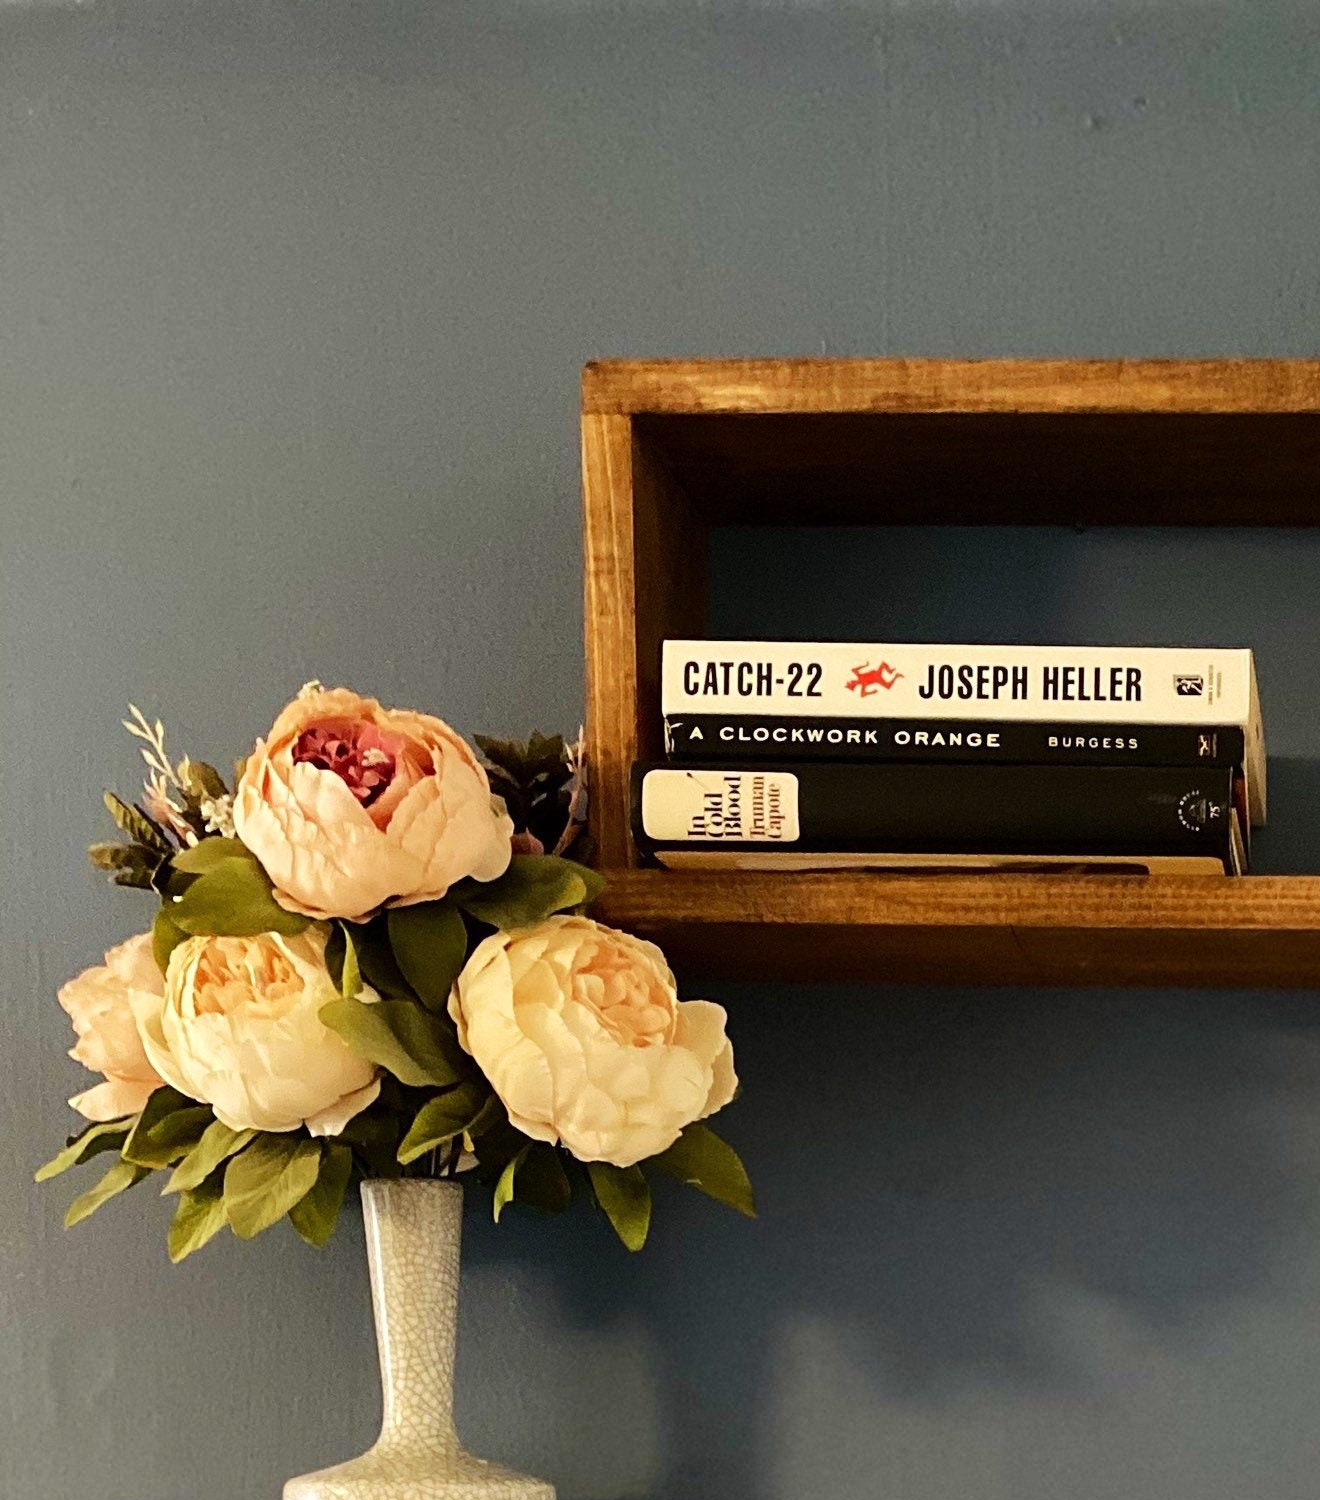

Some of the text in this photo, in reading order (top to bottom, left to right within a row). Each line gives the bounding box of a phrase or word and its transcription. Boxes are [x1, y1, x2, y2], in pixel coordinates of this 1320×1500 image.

[684, 661, 1142, 702] CATCH-22 JOSEPH HELLER
[689, 726, 1138, 749] A CLOCKWORK ORANGE BURGESS
[688, 816, 707, 836] In
[704, 793, 724, 838] Cold
[723, 776, 743, 837] Blood
[750, 776, 766, 837] Truman
[768, 783, 786, 839] Capote
